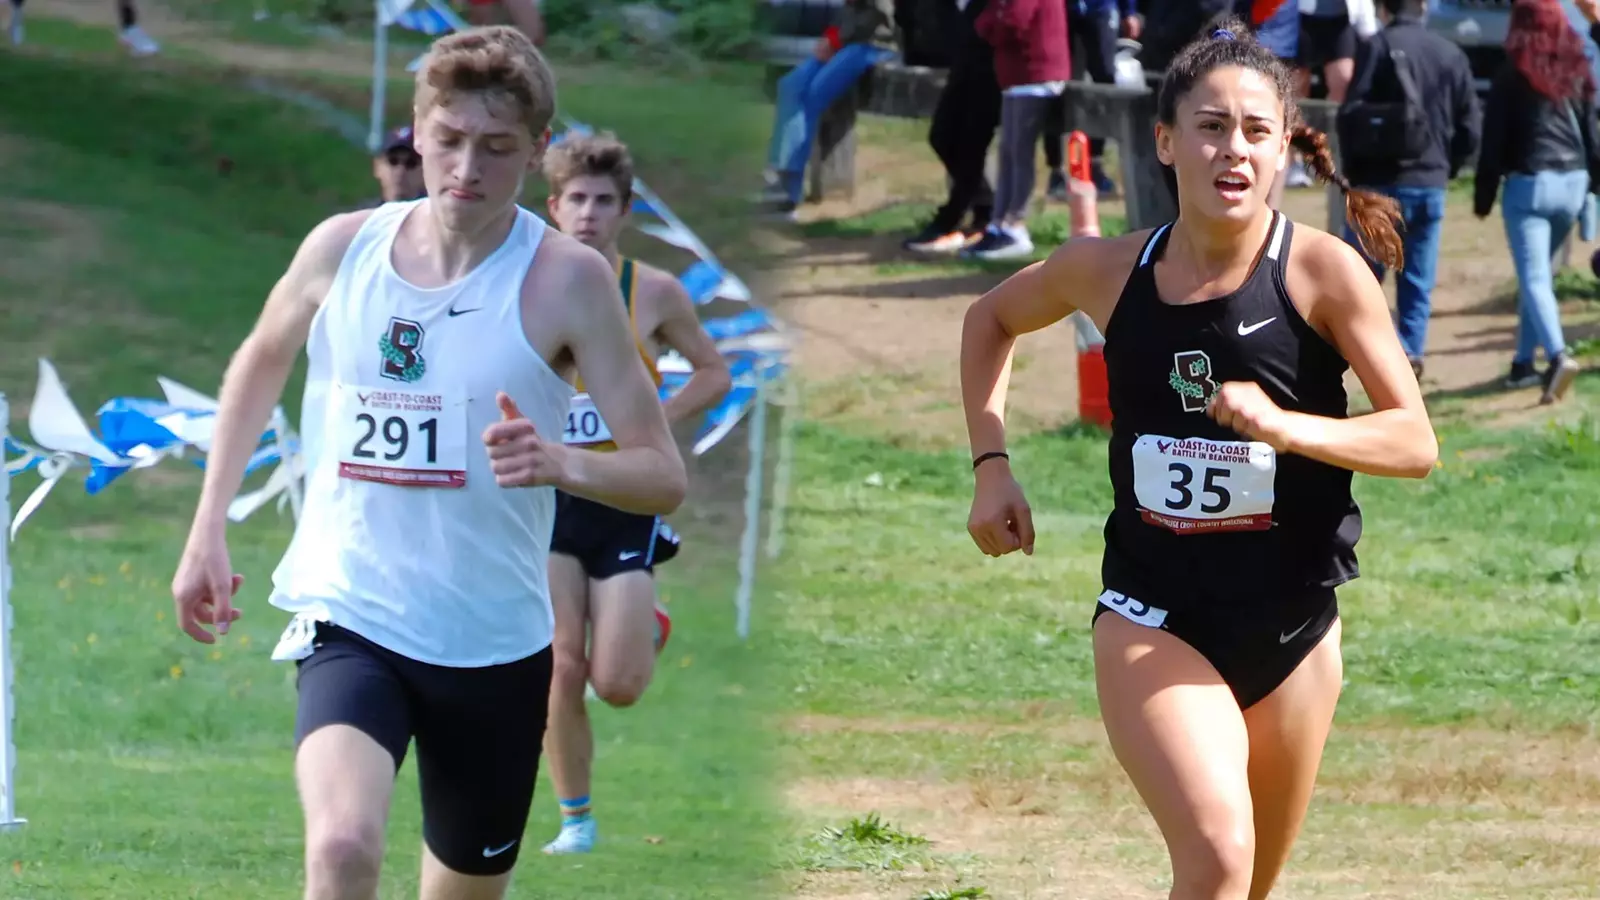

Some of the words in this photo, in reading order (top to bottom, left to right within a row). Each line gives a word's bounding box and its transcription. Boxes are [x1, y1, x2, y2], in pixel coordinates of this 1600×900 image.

[352, 412, 437, 464] 291
[1173, 439, 1251, 456] COAST-TO-COAST
[1172, 449, 1196, 459] BATTLE
[1208, 454, 1251, 464] BEANTOWN
[1164, 462, 1231, 513] 35
